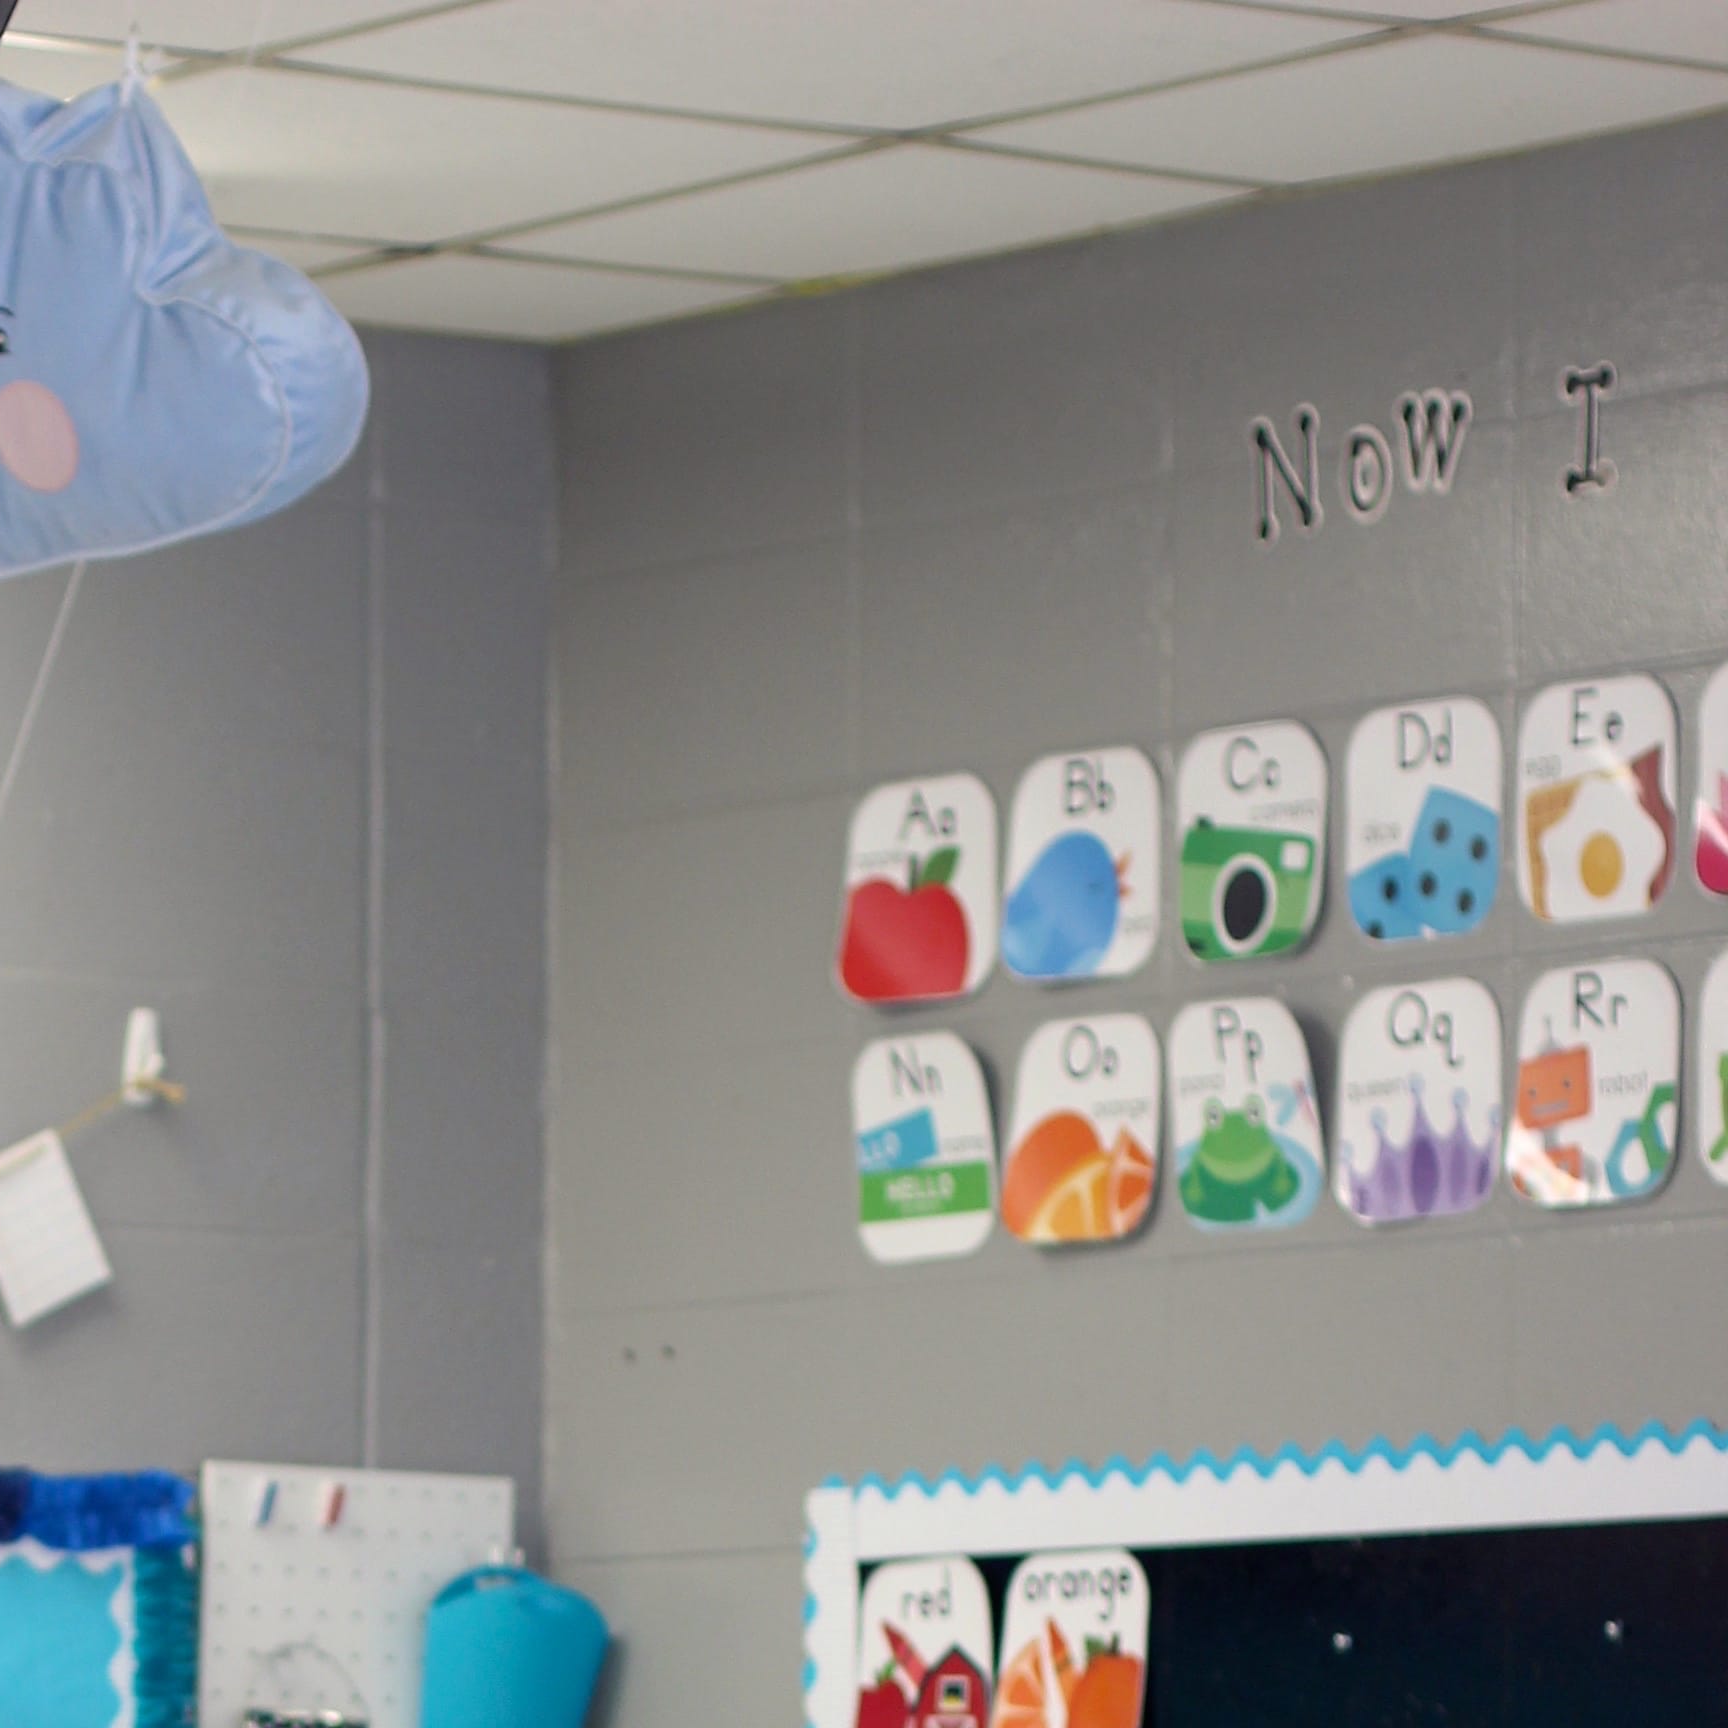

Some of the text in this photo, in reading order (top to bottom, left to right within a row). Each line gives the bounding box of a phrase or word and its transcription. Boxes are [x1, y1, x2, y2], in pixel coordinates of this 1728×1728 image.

[1566, 366, 1614, 491] I
[899, 686, 1624, 840] Aa Bb Cc Dd Ee
[888, 971, 1629, 1097] Nn Oo Pp Qq Rr
[902, 1568, 952, 1619] red
[1024, 1568, 1133, 1620] orange
